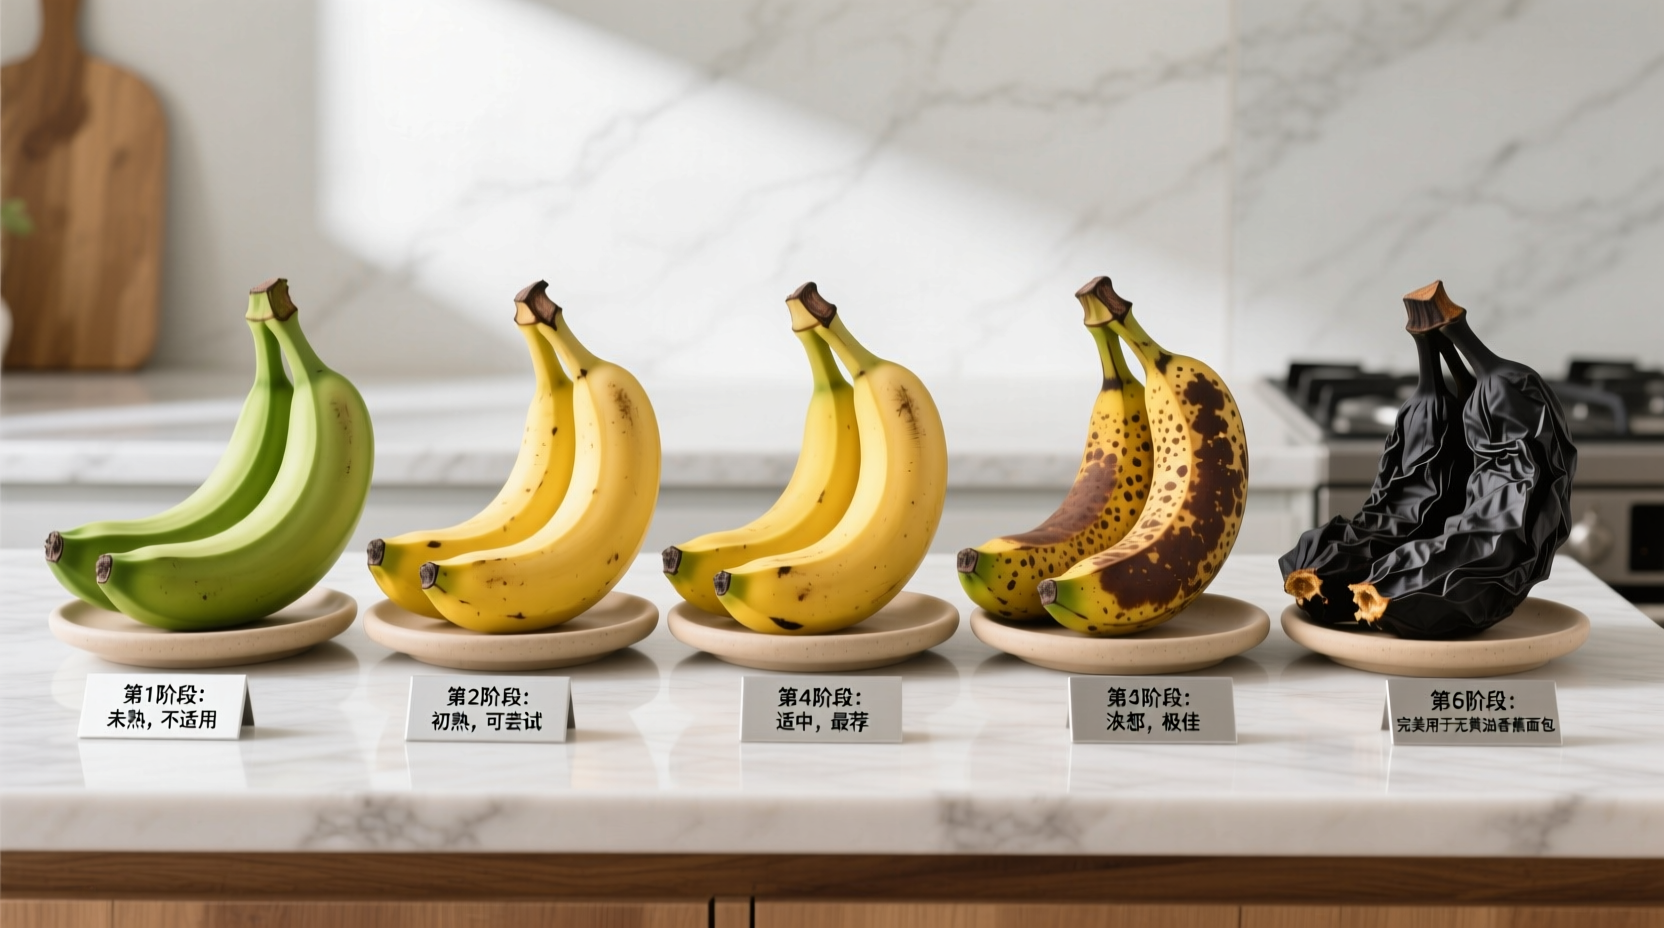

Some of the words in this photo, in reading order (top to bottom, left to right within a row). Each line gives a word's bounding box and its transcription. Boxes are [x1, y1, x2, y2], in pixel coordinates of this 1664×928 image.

[123, 683, 205, 705] 第1阶段：
[446, 685, 529, 707] 第2阶段：
[777, 686, 862, 709] 第4阶段：
[1429, 688, 1515, 712] 第6阶段：
[106, 708, 217, 730] 未熟，不适用
[431, 710, 543, 733] 初熟，可尝试
[775, 710, 869, 732] 适中，最荐
